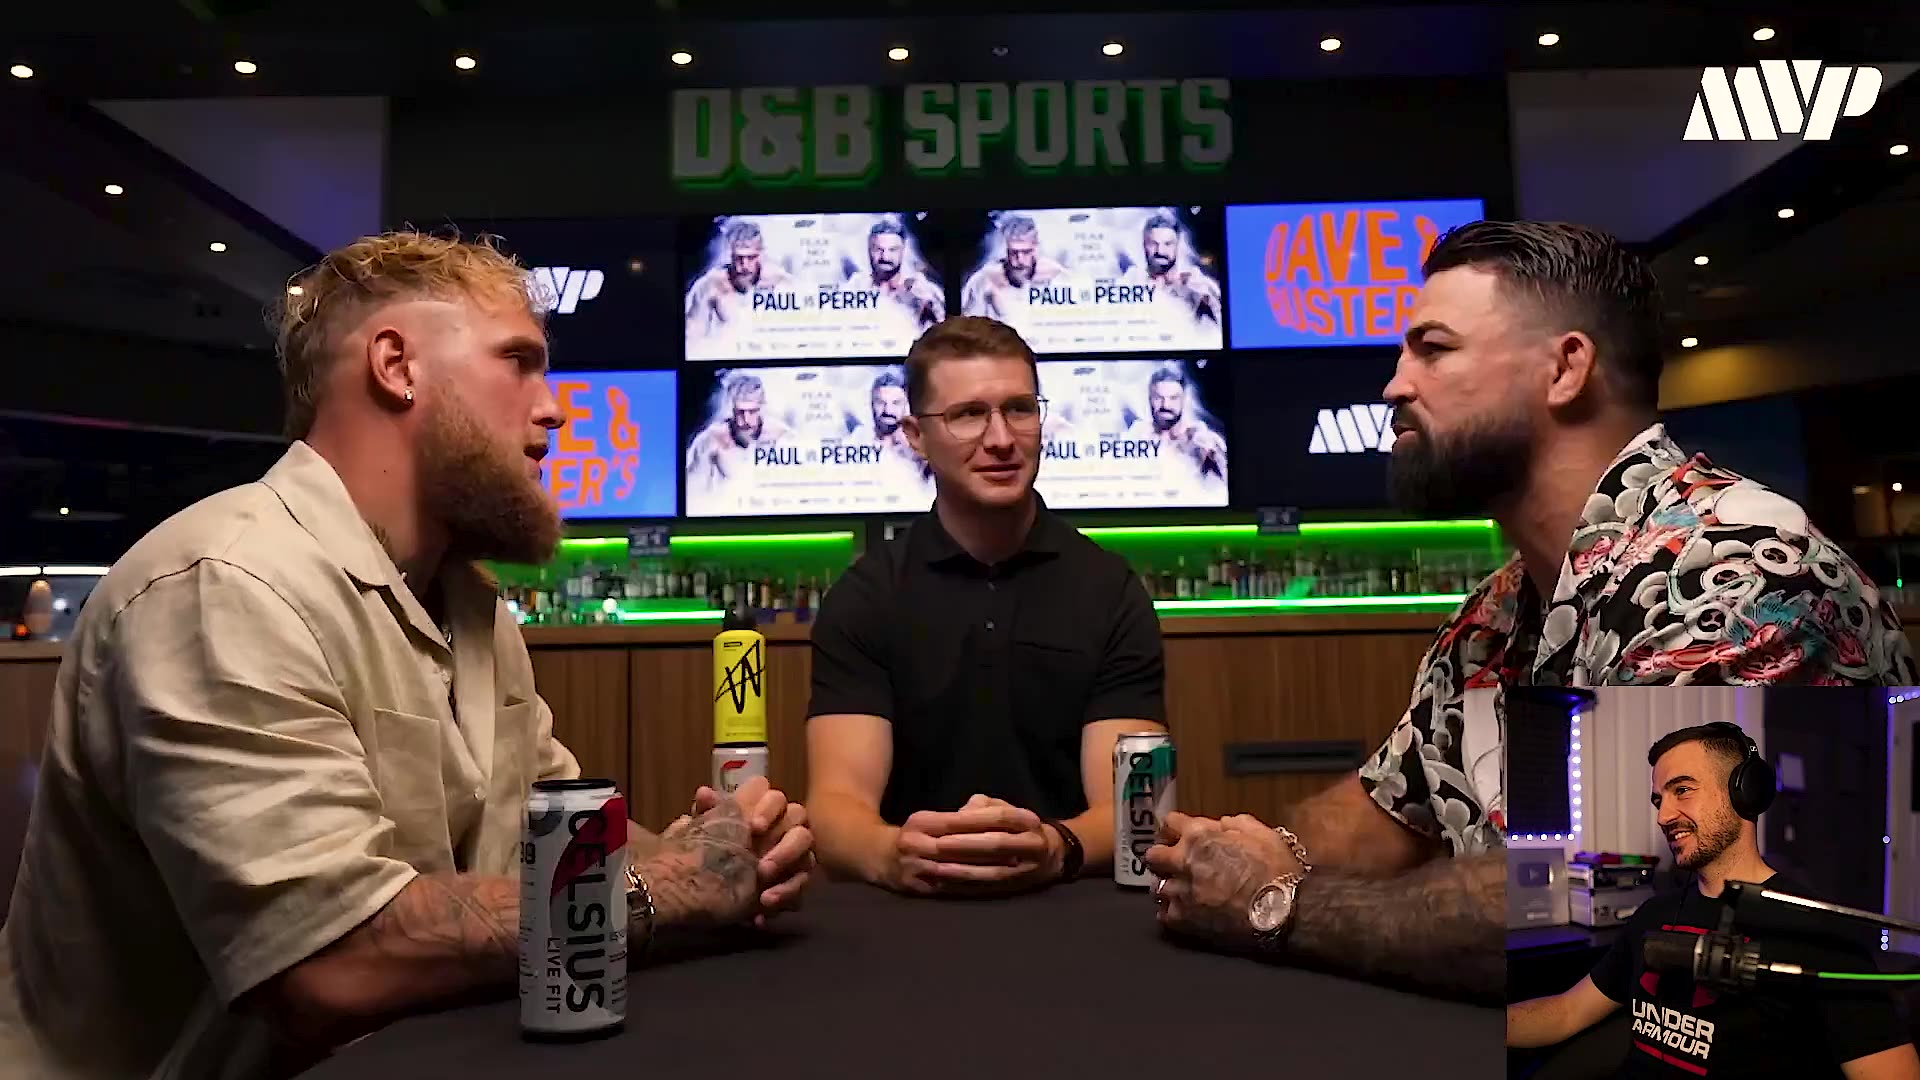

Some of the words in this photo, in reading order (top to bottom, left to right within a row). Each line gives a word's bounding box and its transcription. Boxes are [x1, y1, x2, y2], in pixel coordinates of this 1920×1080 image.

[671, 84, 876, 184] D&B
[903, 79, 1234, 175] SPORTS
[753, 292, 800, 311] PAUL
[819, 291, 881, 310] PERRY
[1029, 287, 1077, 305] PAUL
[1095, 285, 1156, 304] PERRY
[1042, 441, 1081, 460] AUL
[1099, 439, 1161, 459] PERRY
[1308, 403, 1398, 454] MV
[754, 447, 802, 466] PAUL
[820, 445, 883, 464] PERRY
[565, 808, 607, 1013] CELSIUS
[545, 936, 561, 979] LIVE
[545, 983, 562, 1014] FIT
[1631, 998, 1715, 1044] UNDER
[1631, 1018, 1711, 1060] ARMOUR
